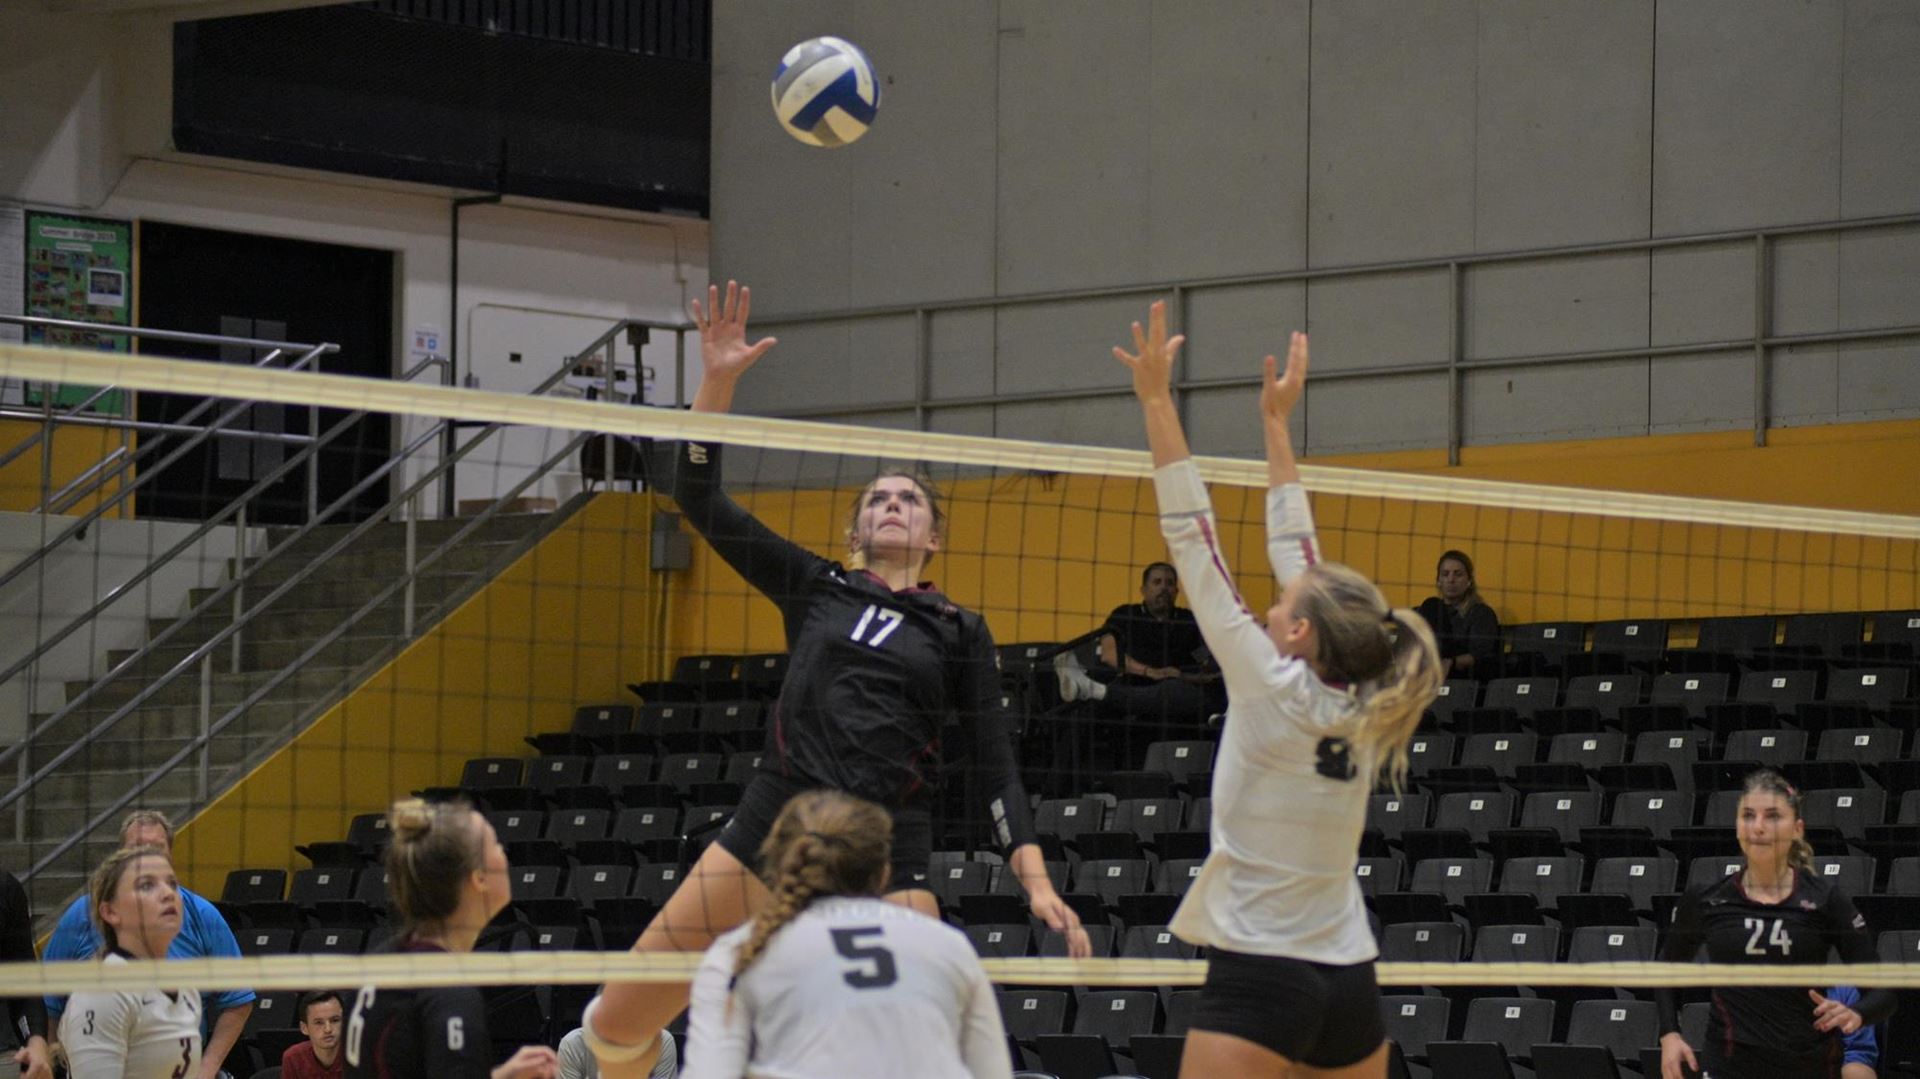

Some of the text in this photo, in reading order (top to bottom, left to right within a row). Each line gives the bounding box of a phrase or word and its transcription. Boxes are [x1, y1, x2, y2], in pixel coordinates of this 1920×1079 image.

[850, 604, 904, 647] 17
[828, 926, 897, 989] 5
[1744, 918, 1793, 955] 24
[83, 1009, 95, 1035] 3
[346, 984, 376, 1067] 6
[447, 1016, 464, 1050] 6
[171, 1037, 192, 1079] 3
